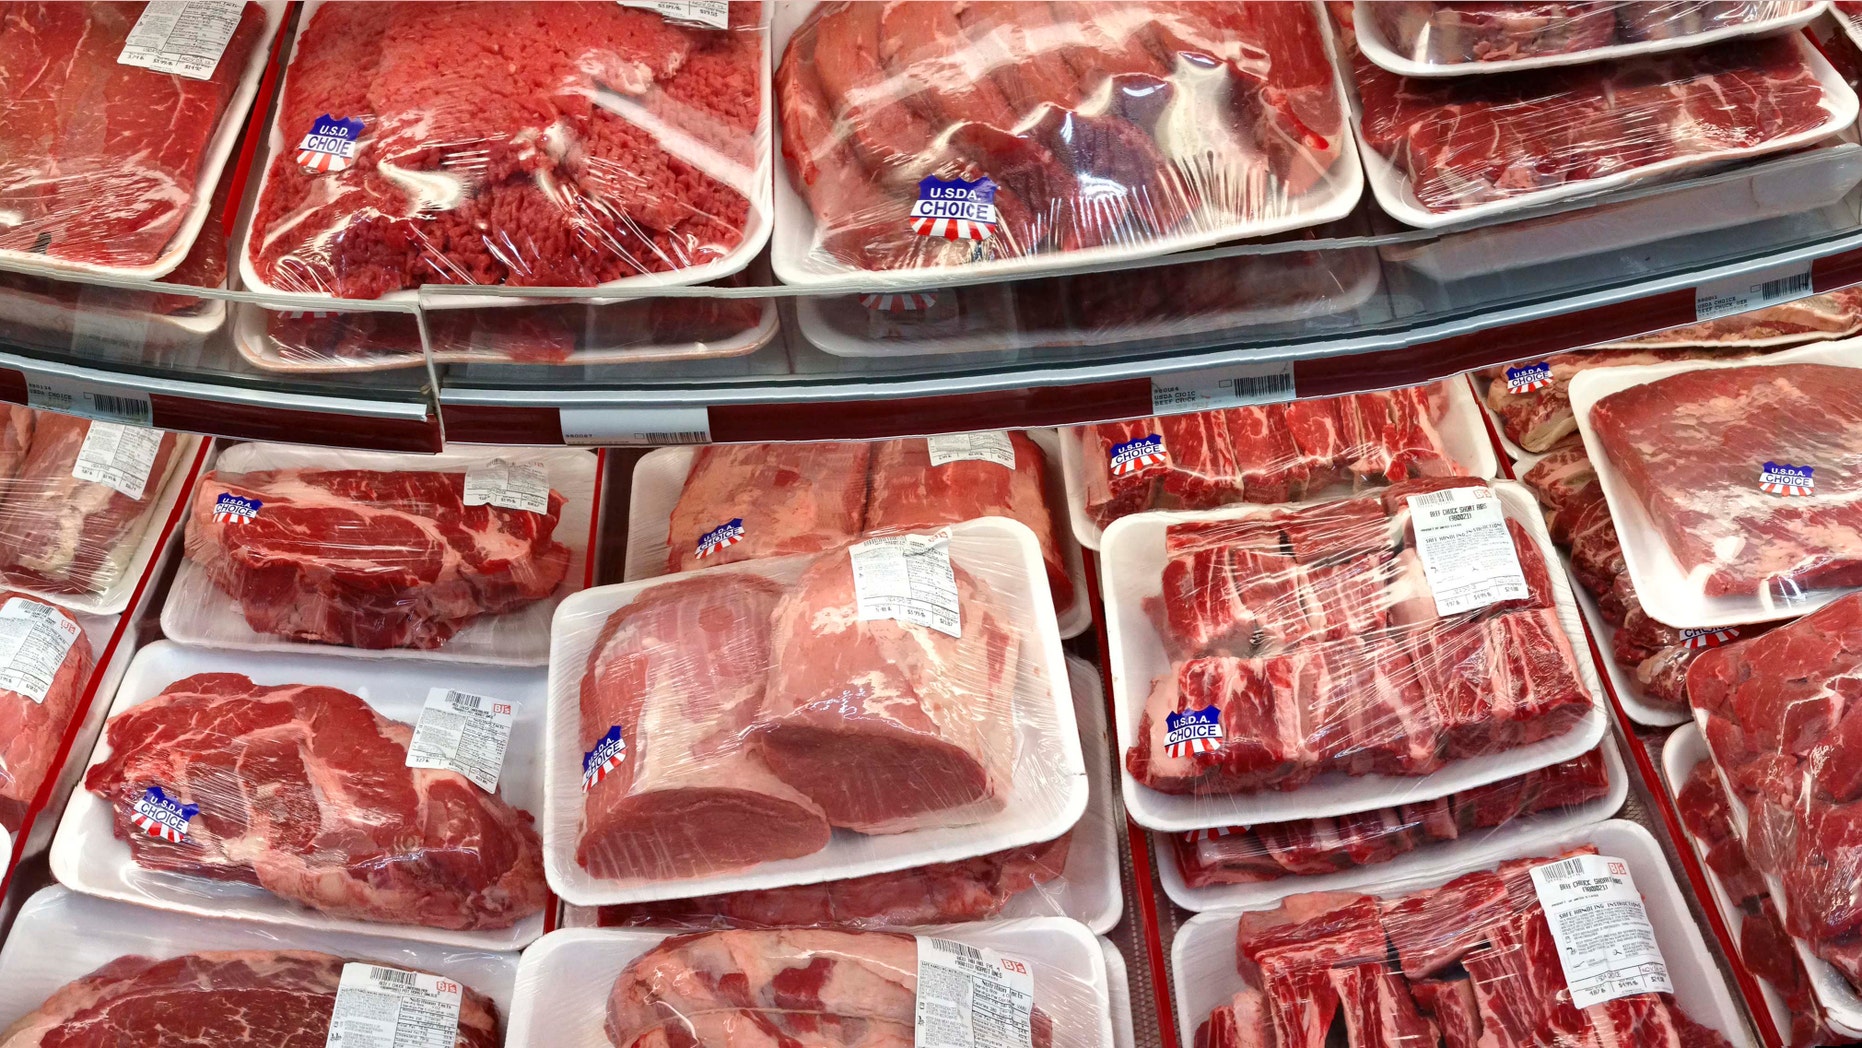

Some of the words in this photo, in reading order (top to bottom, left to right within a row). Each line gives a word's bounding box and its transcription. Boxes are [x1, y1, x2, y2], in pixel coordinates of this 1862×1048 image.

[920, 201, 989, 220] CHOICE
[1511, 371, 1549, 387] CHOICE
[1115, 445, 1160, 464] CHOICE
[1765, 474, 1810, 486] CHOICE
[216, 504, 254, 517] CHOICE
[700, 527, 740, 550] CHOICE
[1173, 715, 1211, 728] U.S.D.A.
[1169, 725, 1217, 743] CHOICE
[586, 741, 621, 779] CHOICE
[141, 803, 186, 831] CHOICE
